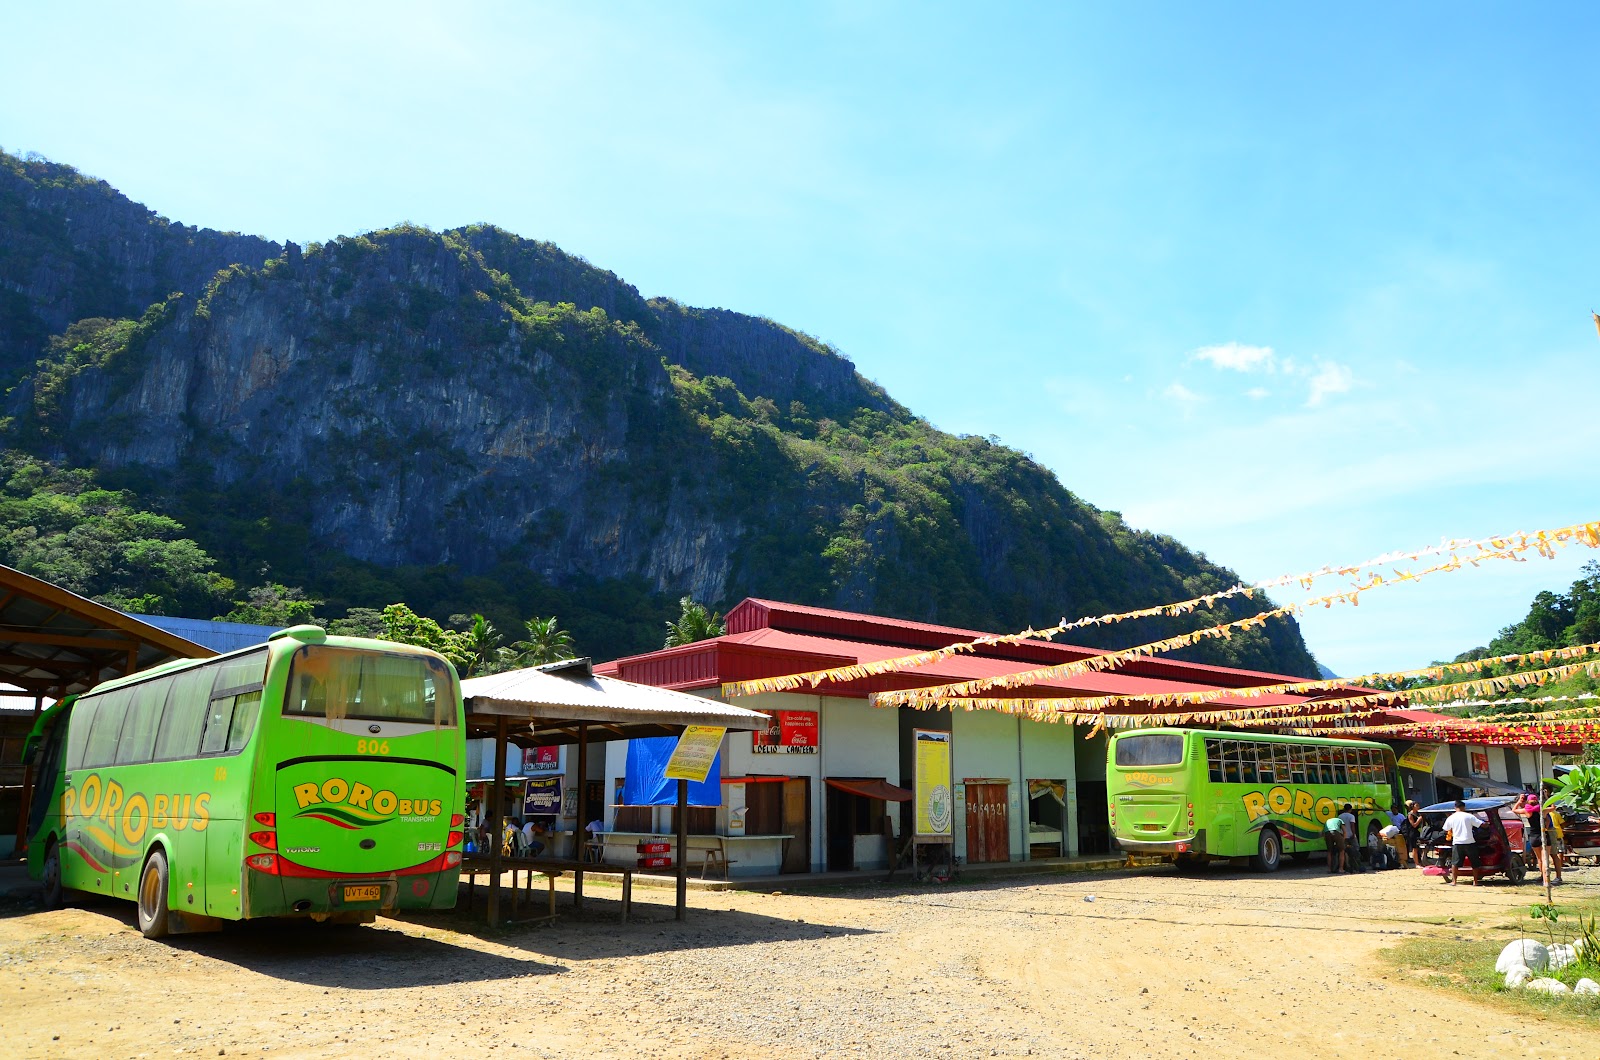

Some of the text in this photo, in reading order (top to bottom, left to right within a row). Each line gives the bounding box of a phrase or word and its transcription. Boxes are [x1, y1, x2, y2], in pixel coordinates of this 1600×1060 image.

[357, 739, 390, 755] 806
[787, 745, 814, 754] CANTEEN
[60, 773, 212, 846] RORO BUS
[293, 777, 443, 816] RORO BUS
[1242, 786, 1336, 824] RORO
